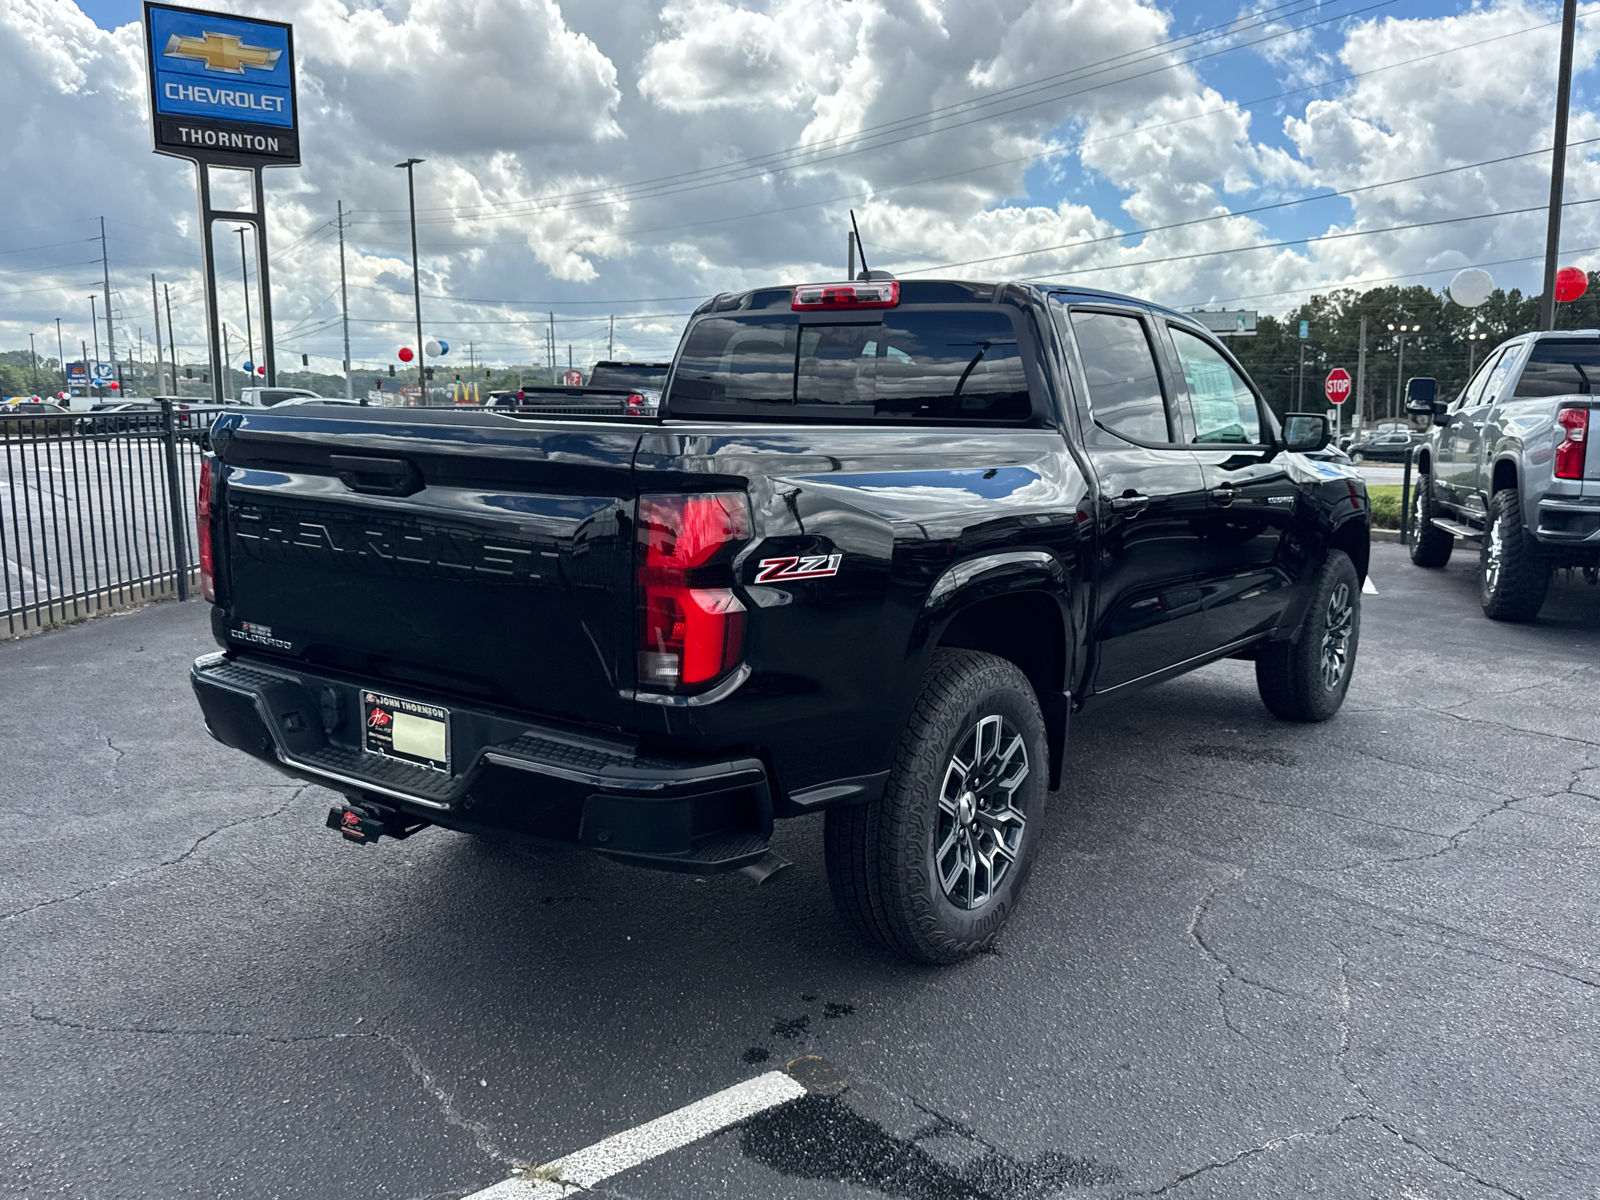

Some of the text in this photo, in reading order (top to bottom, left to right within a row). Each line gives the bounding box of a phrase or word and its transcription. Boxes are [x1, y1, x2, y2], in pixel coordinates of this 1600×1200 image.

[165, 82, 285, 112] CHEVROLET
[178, 127, 279, 152] THORNTON
[1327, 379, 1350, 393] STOP
[235, 512, 560, 581] CHEVROLET
[754, 553, 842, 584] Z71
[231, 629, 293, 650] COLORADO
[379, 696, 401, 709] JOHN
